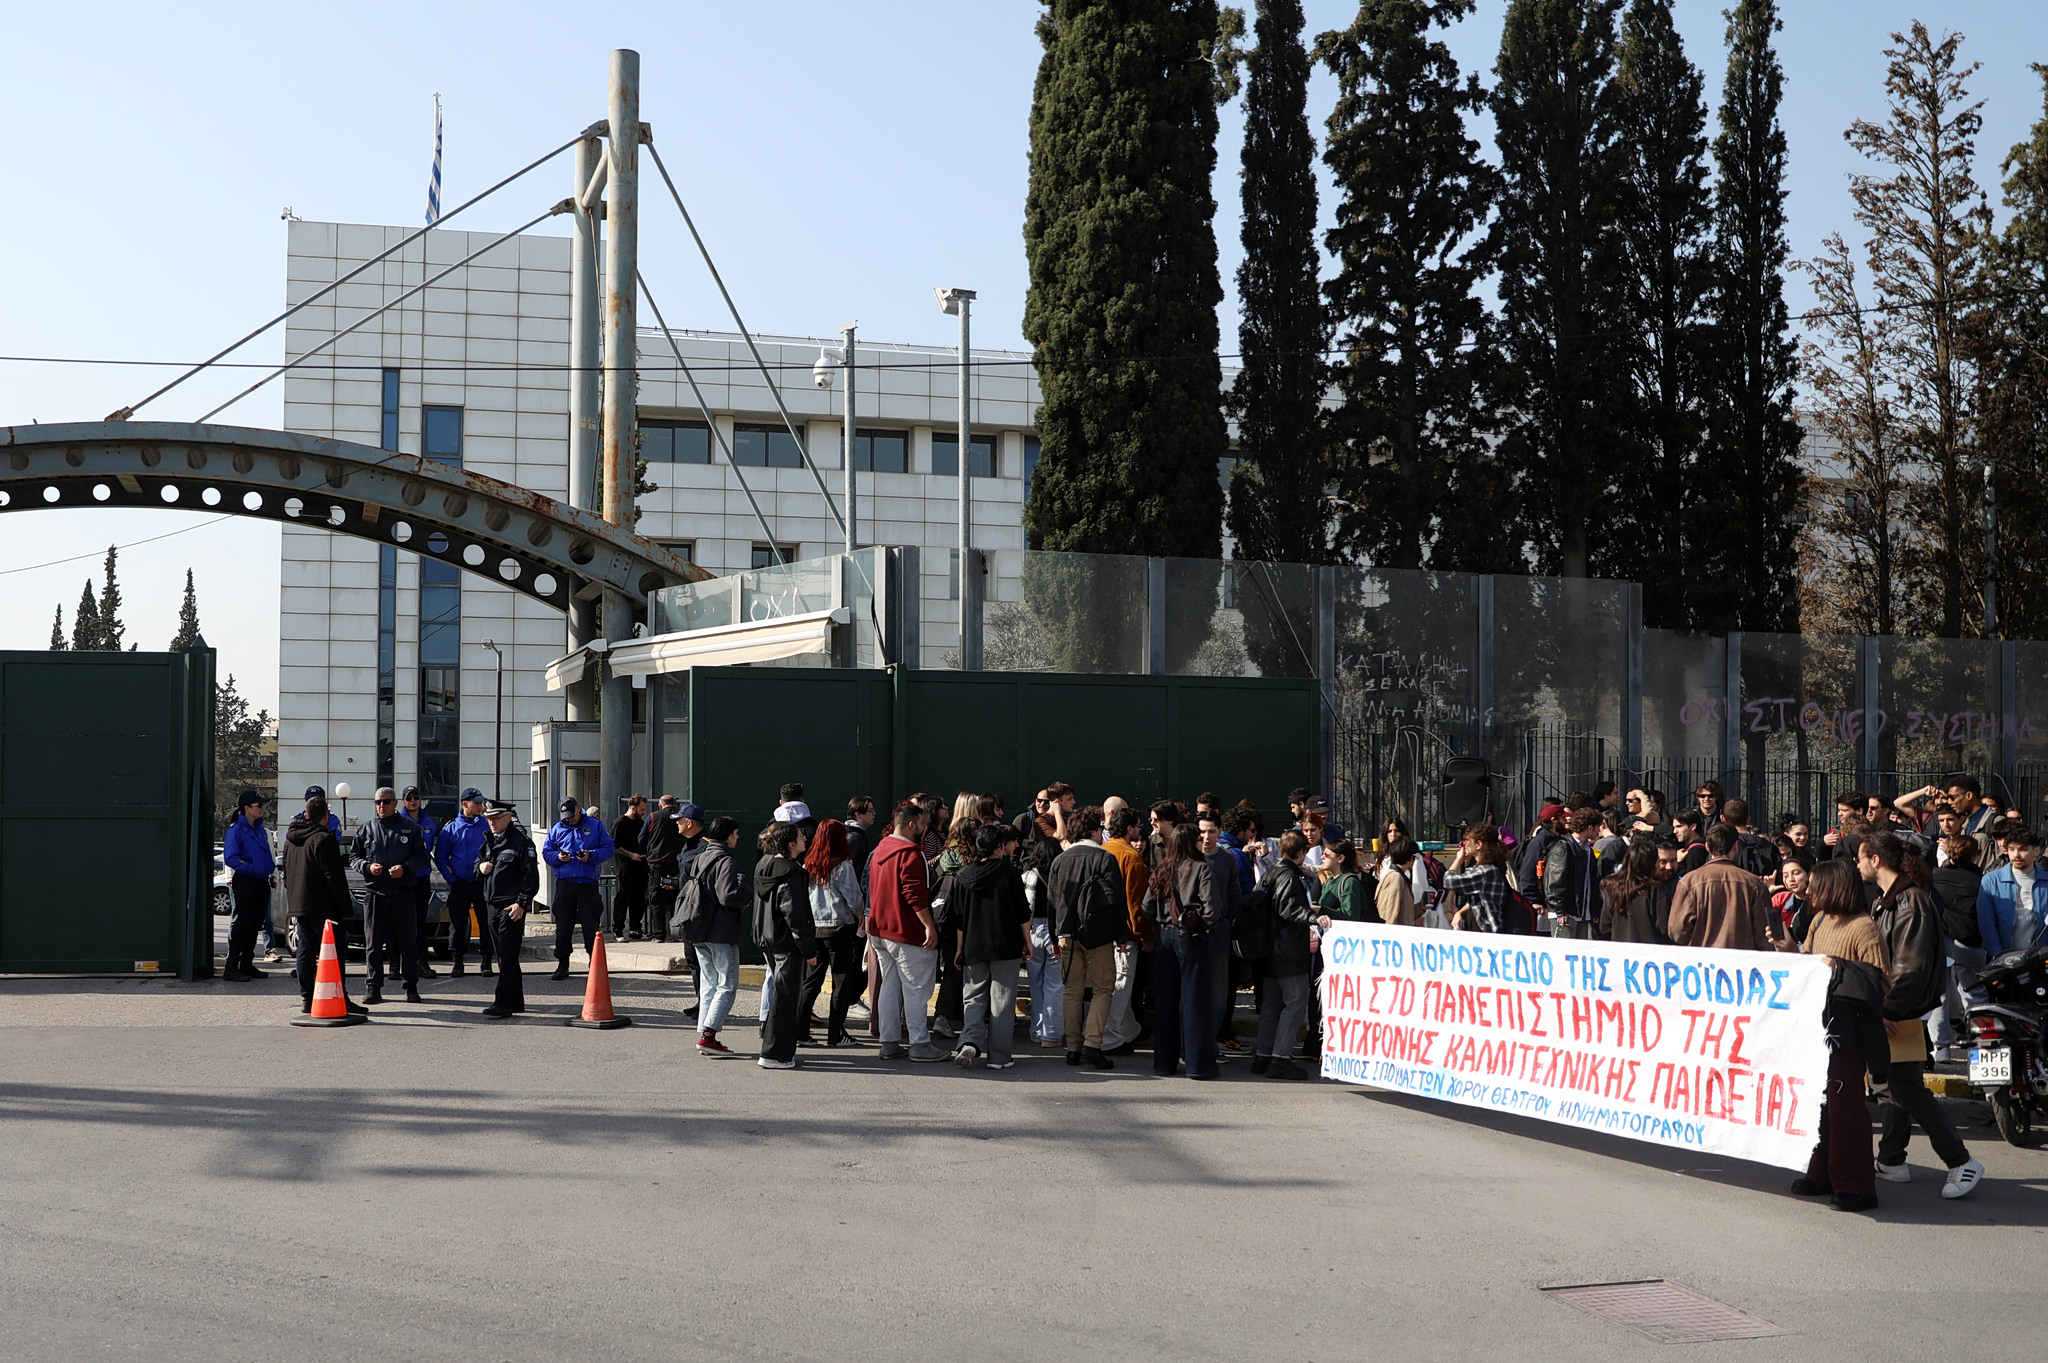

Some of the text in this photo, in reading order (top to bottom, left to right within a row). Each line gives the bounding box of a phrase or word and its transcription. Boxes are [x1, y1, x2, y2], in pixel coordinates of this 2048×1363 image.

[1365, 676, 1445, 695] ΣΕ ΚΑΘΕ
[1413, 699, 1494, 727] ΑΝΟΜΙΑΣ
[1744, 696, 1823, 733] ΣΤΟ
[1831, 708, 1888, 743] ΝΕΟ
[1906, 710, 2036, 747] ΣΥΣΤΗΜΑ
[1332, 936, 1790, 1010] ΟΧΙ ΣΤΟ ΝΟΜΟΣΧΕΔΙΟ ΤΗΣ ΚΟΡΟΪΔΙΑΣ
[1328, 973, 1751, 1066] ΝΑΙ ΣΤΟ ΠΑΝΕΠΙΣΤΗΜΙΟ ΤΗΣ
[1326, 1016, 1808, 1137] ΣΥΓΧΡΟΝΗΣ ΚΑΛΛΙΤΕΧΝΙΚΗΣ ΠΑΙΔΕΙΑΣ
[1980, 1052, 2009, 1063] MPP
[1981, 1066, 2009, 1077] 396
[1447, 1076, 1490, 1103] ΧΟΡΟΥ
[1491, 1087, 1552, 1117] ΘΕΑΤΡΟΥ
[1557, 1100, 1706, 1147] ΚΙΝΗΜΑΤΟΓΡΑΦΟΥ
